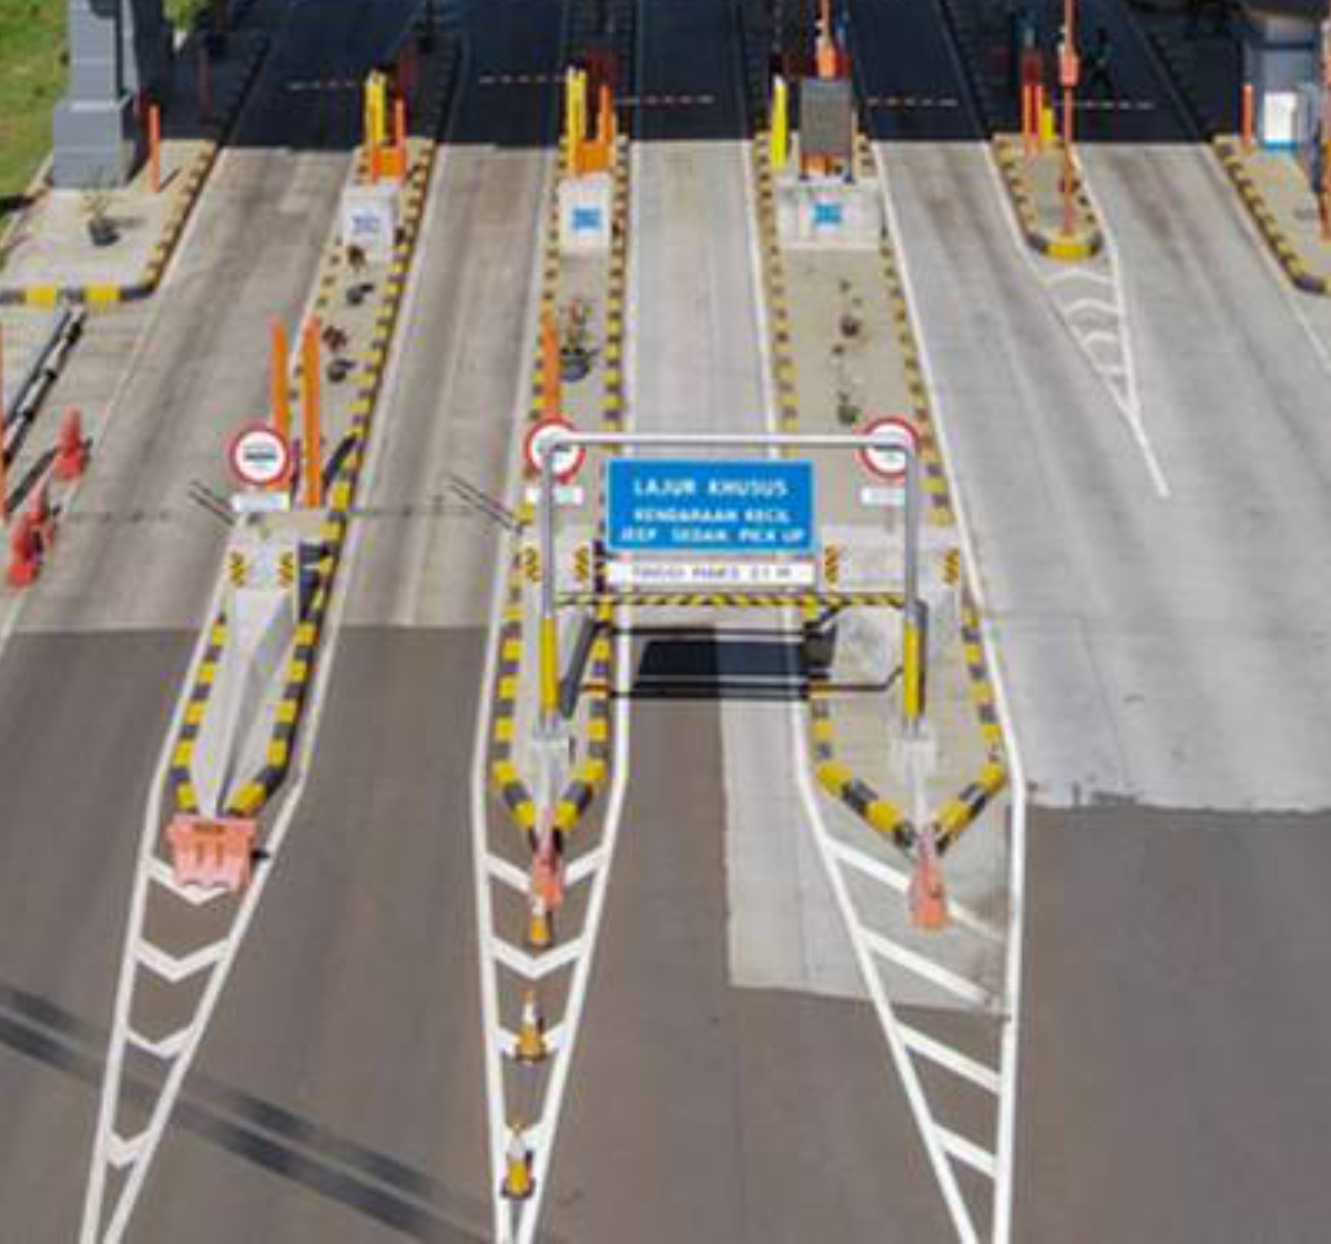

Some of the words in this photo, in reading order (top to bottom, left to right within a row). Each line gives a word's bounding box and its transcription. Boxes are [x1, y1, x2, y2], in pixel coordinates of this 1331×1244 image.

[634, 478, 695, 498] LAJUR
[708, 477, 788, 498] KHUSUS
[634, 508, 738, 523] KENDARAAN
[745, 508, 790, 523] KECIL
